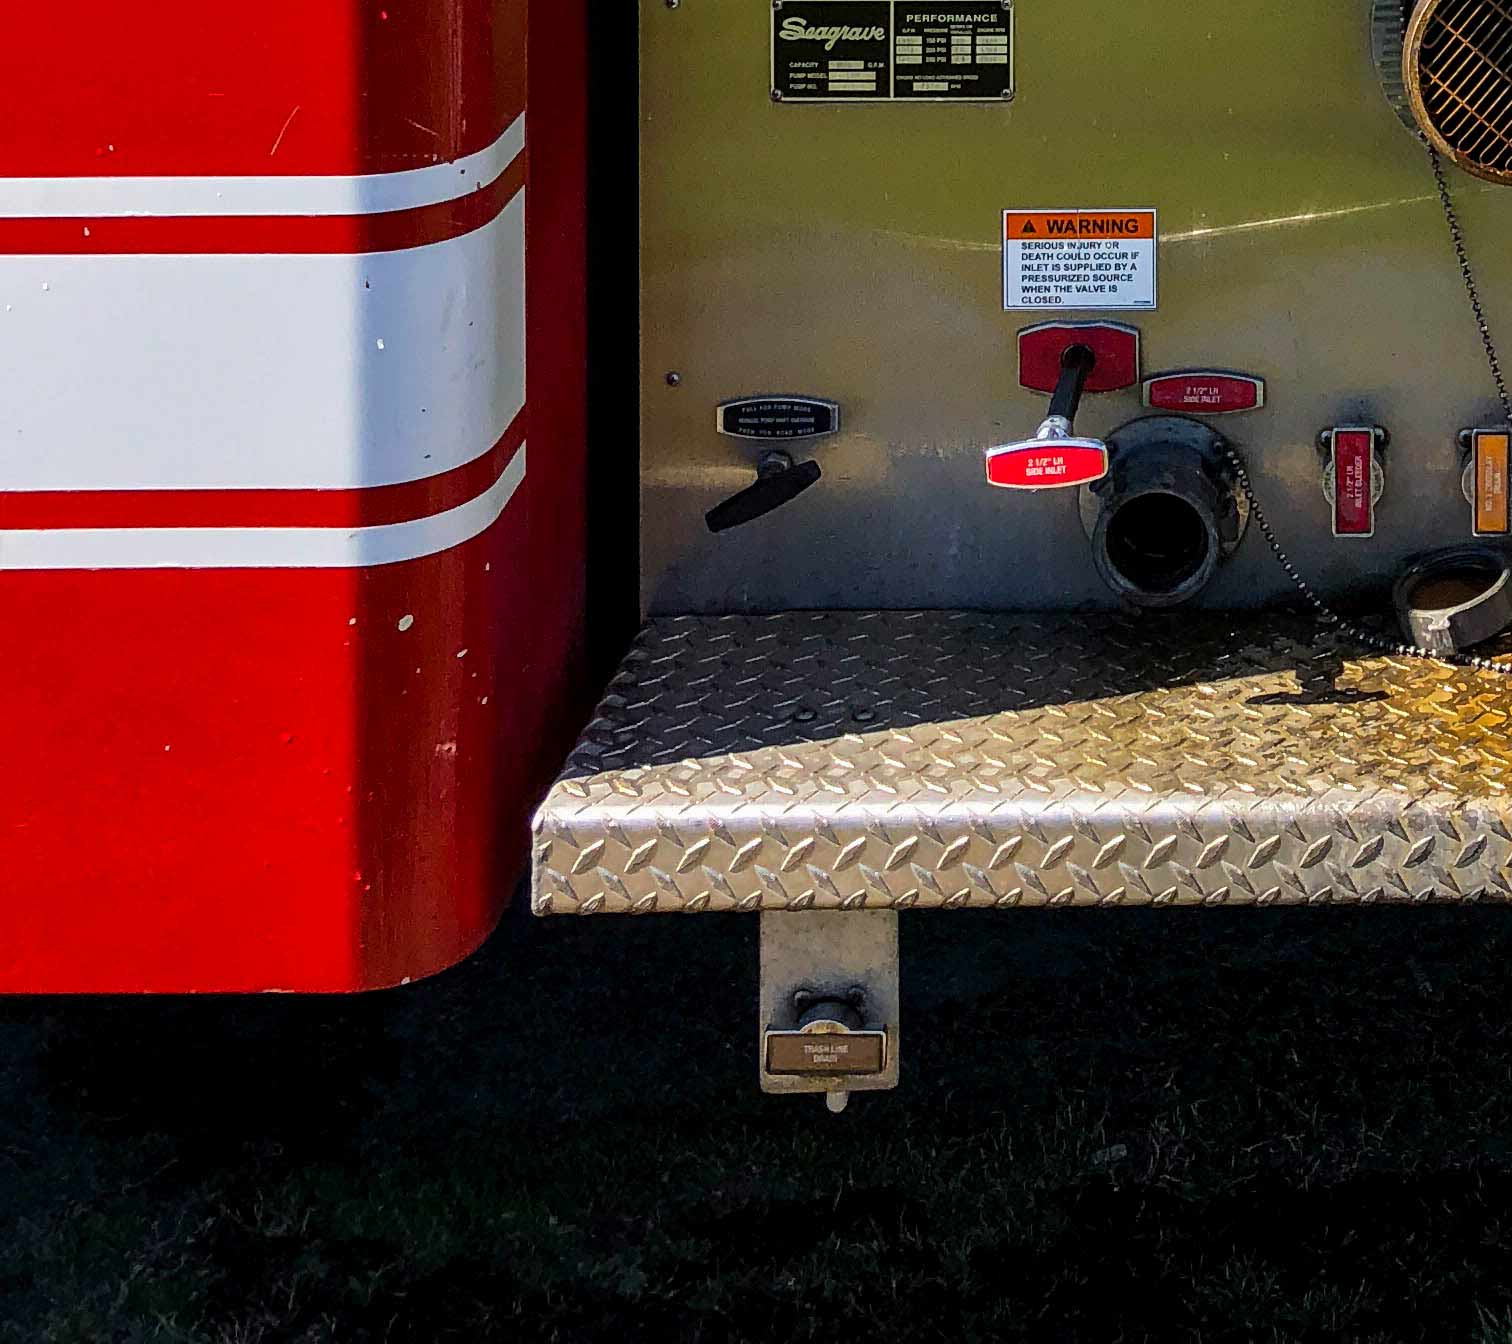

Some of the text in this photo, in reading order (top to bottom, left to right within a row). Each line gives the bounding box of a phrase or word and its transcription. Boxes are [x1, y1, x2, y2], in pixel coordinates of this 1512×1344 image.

[906, 14, 997, 23] PERFORMANCE
[779, 17, 885, 51] Seagrave
[1047, 219, 1139, 233] WARNING
[1022, 242, 1064, 250] SERIOUS
[1068, 242, 1101, 250] INJURY
[1057, 252, 1090, 260] COULD
[1094, 252, 1128, 260] OCCUR
[1064, 263, 1111, 271] SUPPLIED
[1022, 274, 1133, 282] PRESSURIZED SOURCE
[1028, 459, 1033, 467] 2
[1025, 465, 1067, 477] SIDE INLET
